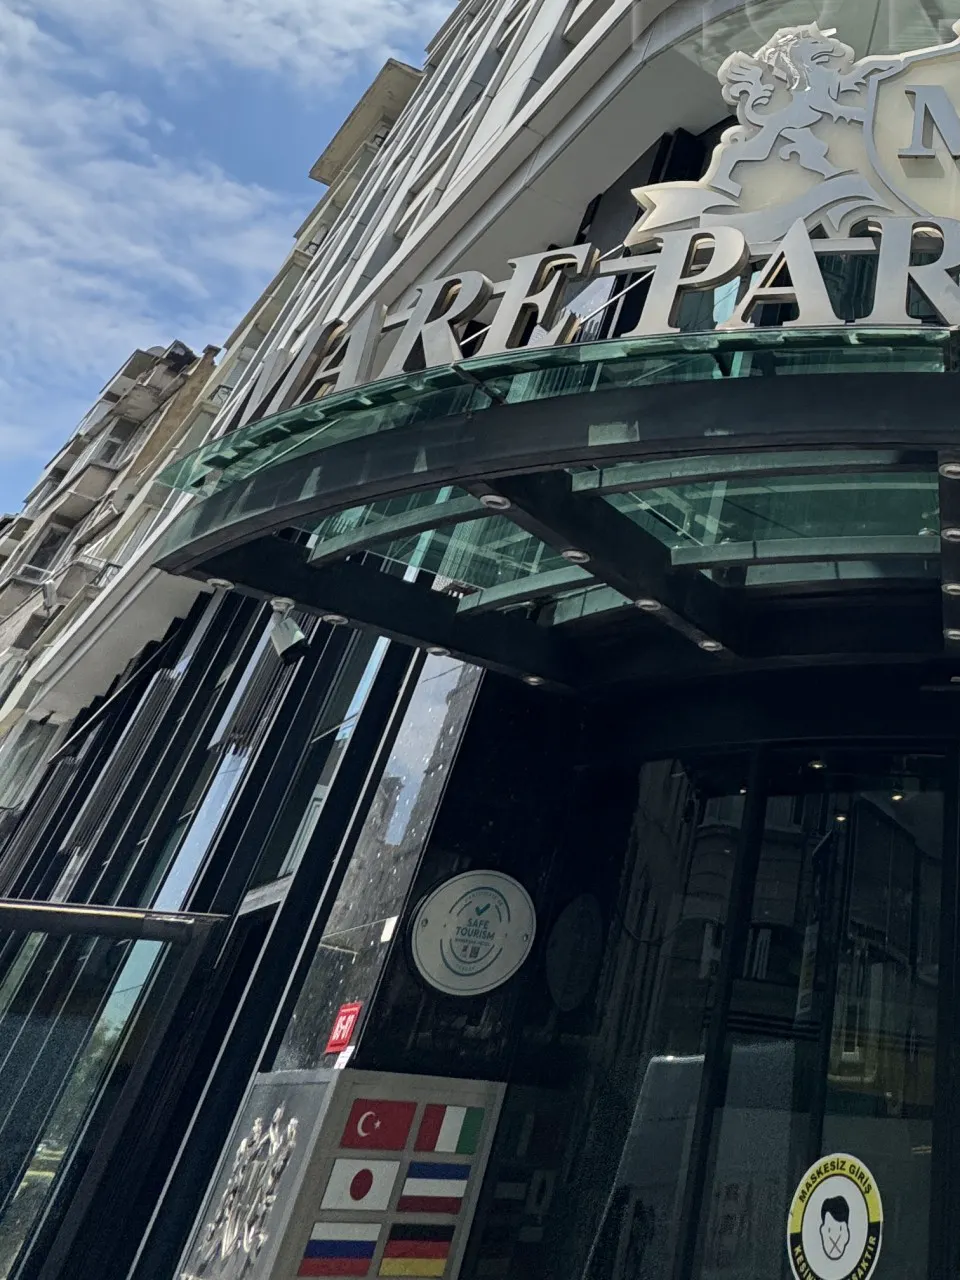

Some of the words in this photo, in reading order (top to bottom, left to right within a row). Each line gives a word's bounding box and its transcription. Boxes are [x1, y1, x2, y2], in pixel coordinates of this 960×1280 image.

[467, 918, 490, 929] SAFE
[455, 926, 495, 941] TOURISM
[798, 1157, 847, 1204] MASKESİZ
[848, 1164, 873, 1195] GİRİŞ
